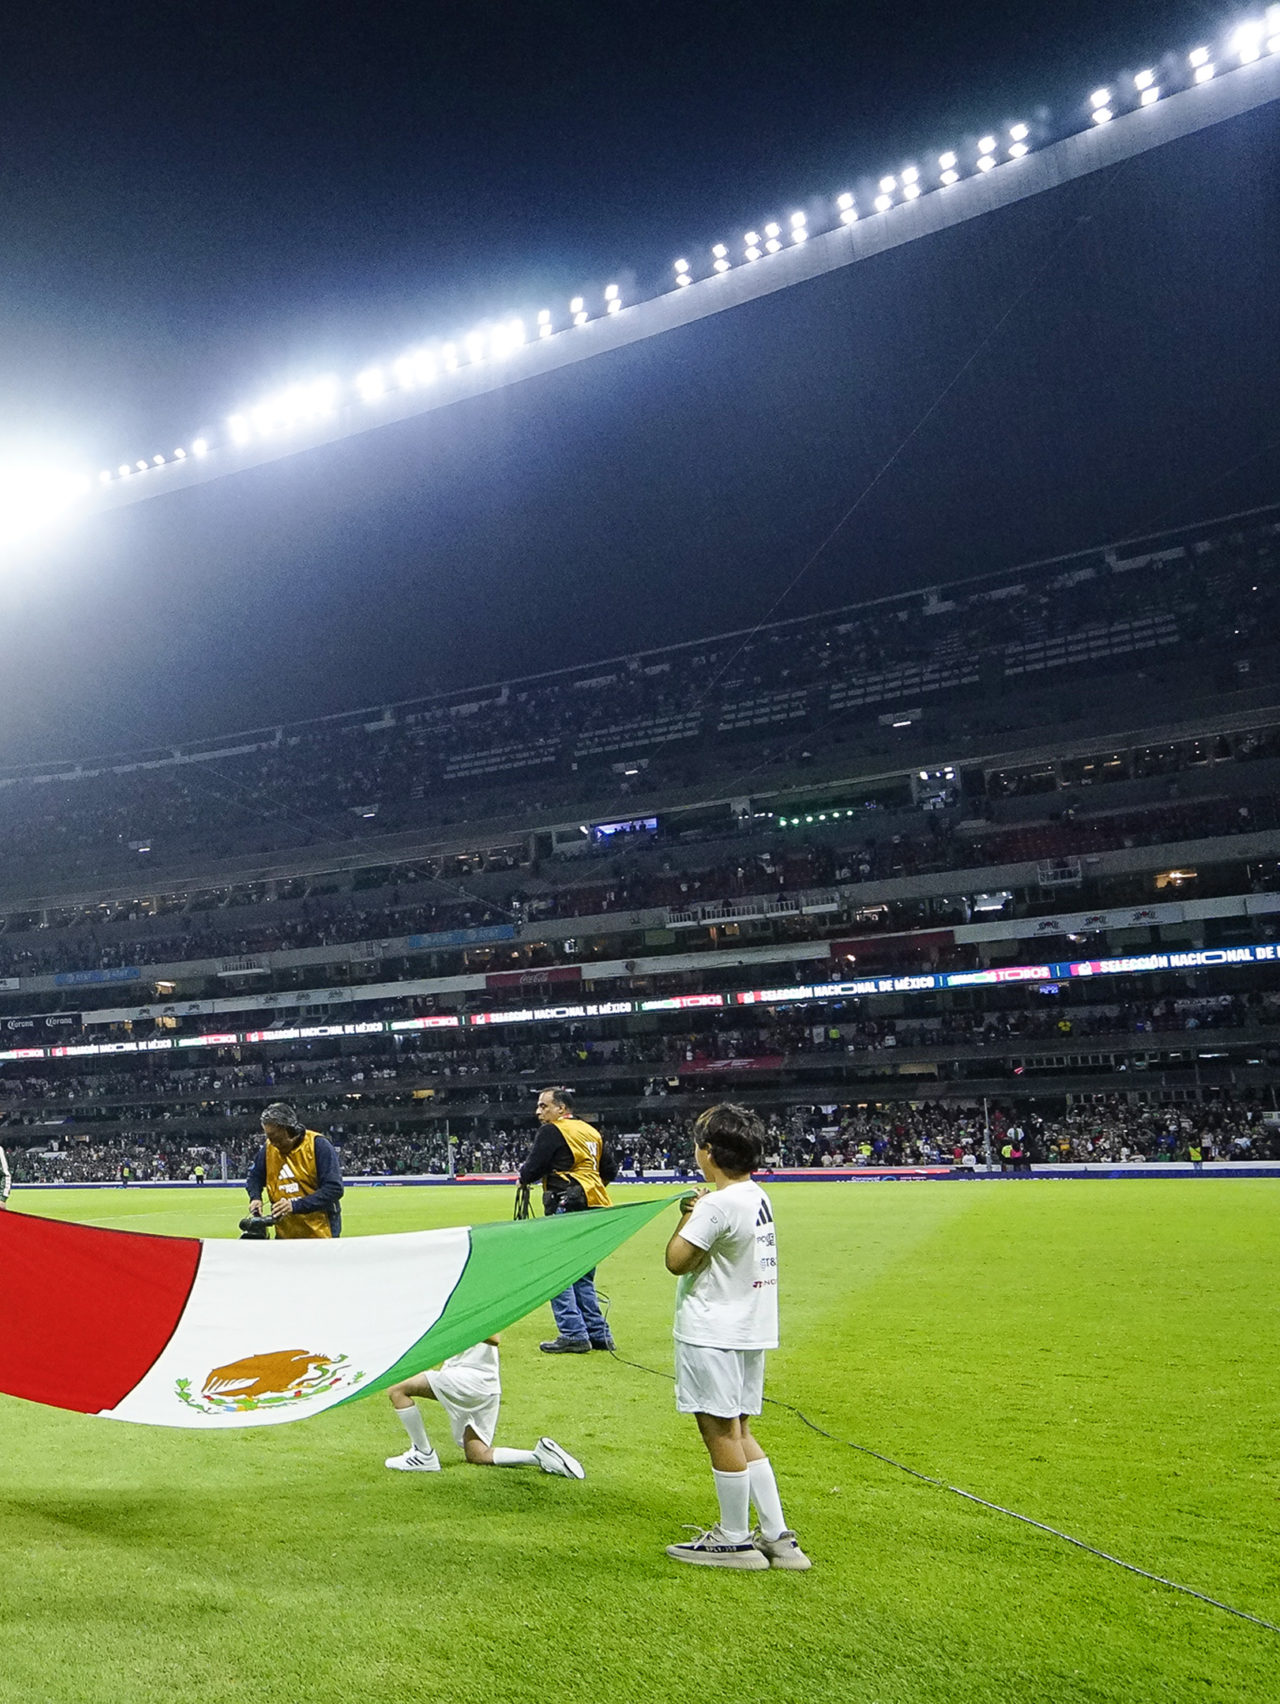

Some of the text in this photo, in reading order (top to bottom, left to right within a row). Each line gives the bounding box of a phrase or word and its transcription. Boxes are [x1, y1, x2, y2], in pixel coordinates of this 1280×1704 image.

[1100, 955, 1168, 973] SELECCIÓN
[1170, 948, 1254, 968] NACIONAL
[1255, 946, 1275, 960] DE
[760, 985, 813, 1002] SELECCIÓN
[814, 981, 877, 997] NACIONAL
[879, 978, 894, 993] DE
[894, 974, 935, 991] MÉXICO
[534, 1006, 586, 1020] NACIONAL
[587, 1005, 599, 1016] DE
[599, 1002, 631, 1015] MÉXICO
[7, 1016, 73, 1030] Corona Corona
[345, 1023, 355, 1034] DE
